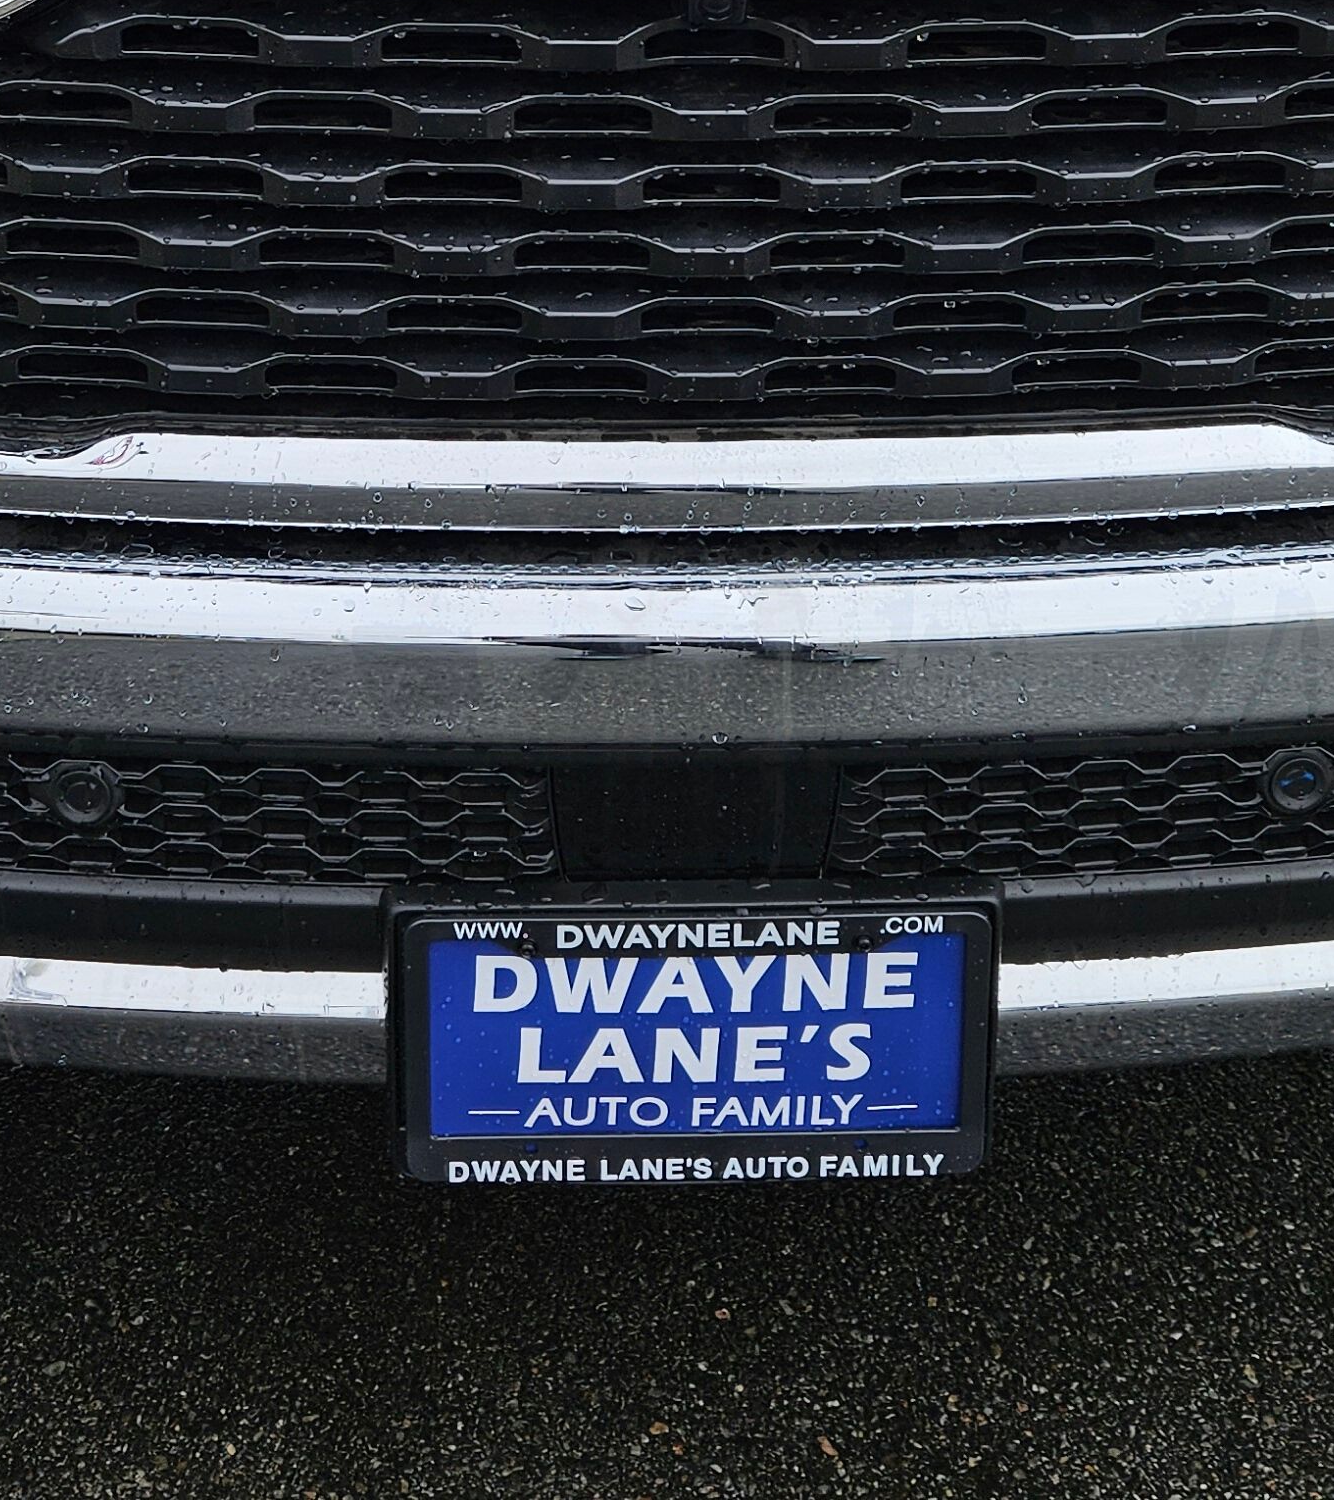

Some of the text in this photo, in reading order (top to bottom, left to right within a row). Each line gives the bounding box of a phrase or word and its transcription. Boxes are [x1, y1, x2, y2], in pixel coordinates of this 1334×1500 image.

[556, 920, 840, 949] DWAYNELANE
[880, 915, 944, 934] .COM
[472, 952, 919, 1014] DWAYNE
[517, 1023, 871, 1084] LANE'S
[523, 1093, 864, 1127] AUTO FAMILY
[448, 1153, 944, 1183] DWAYNE LANE'S AUTO FAMILY
